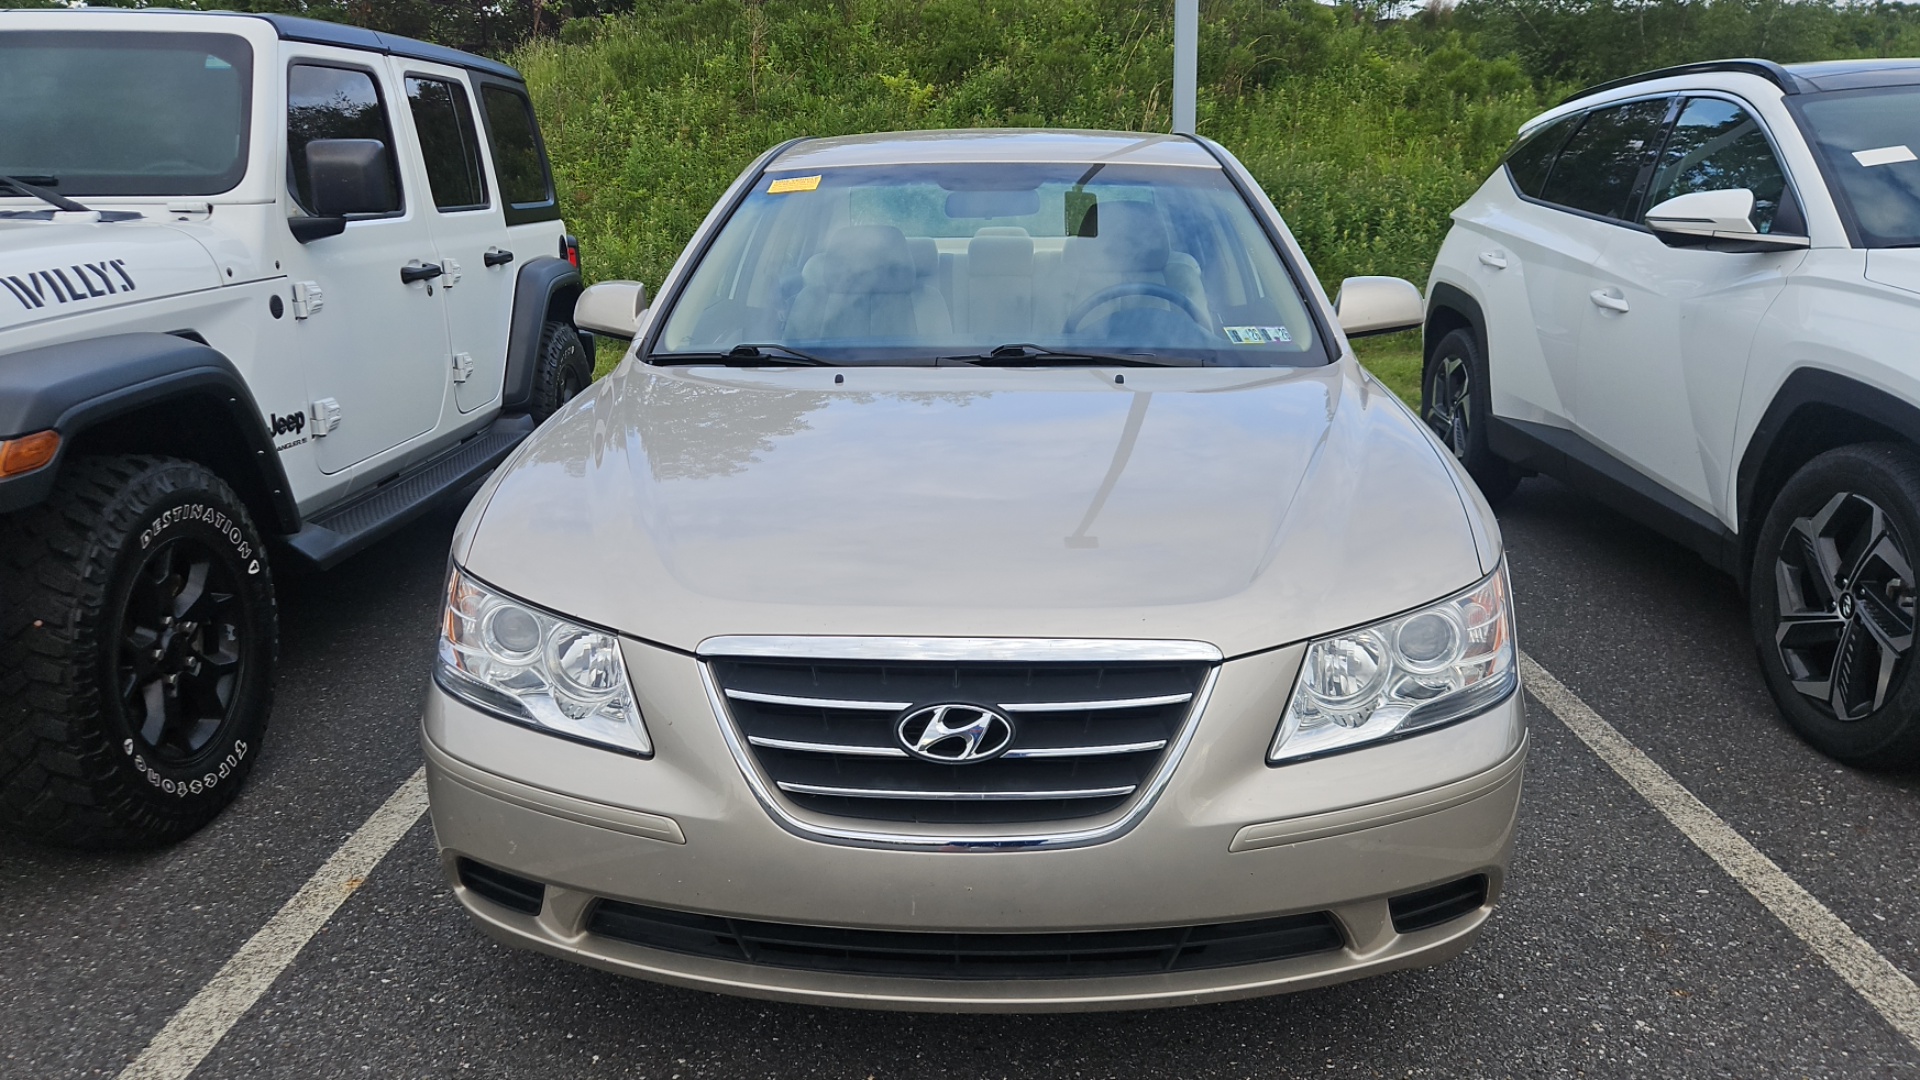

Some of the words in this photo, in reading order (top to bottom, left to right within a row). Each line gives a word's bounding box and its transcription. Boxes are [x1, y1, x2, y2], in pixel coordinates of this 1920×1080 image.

[0, 259, 136, 309] WILLYS
[268, 411, 305, 438] Jeep
[276, 439, 302, 451] ANGLER
[140, 504, 252, 559] DESTINATION
